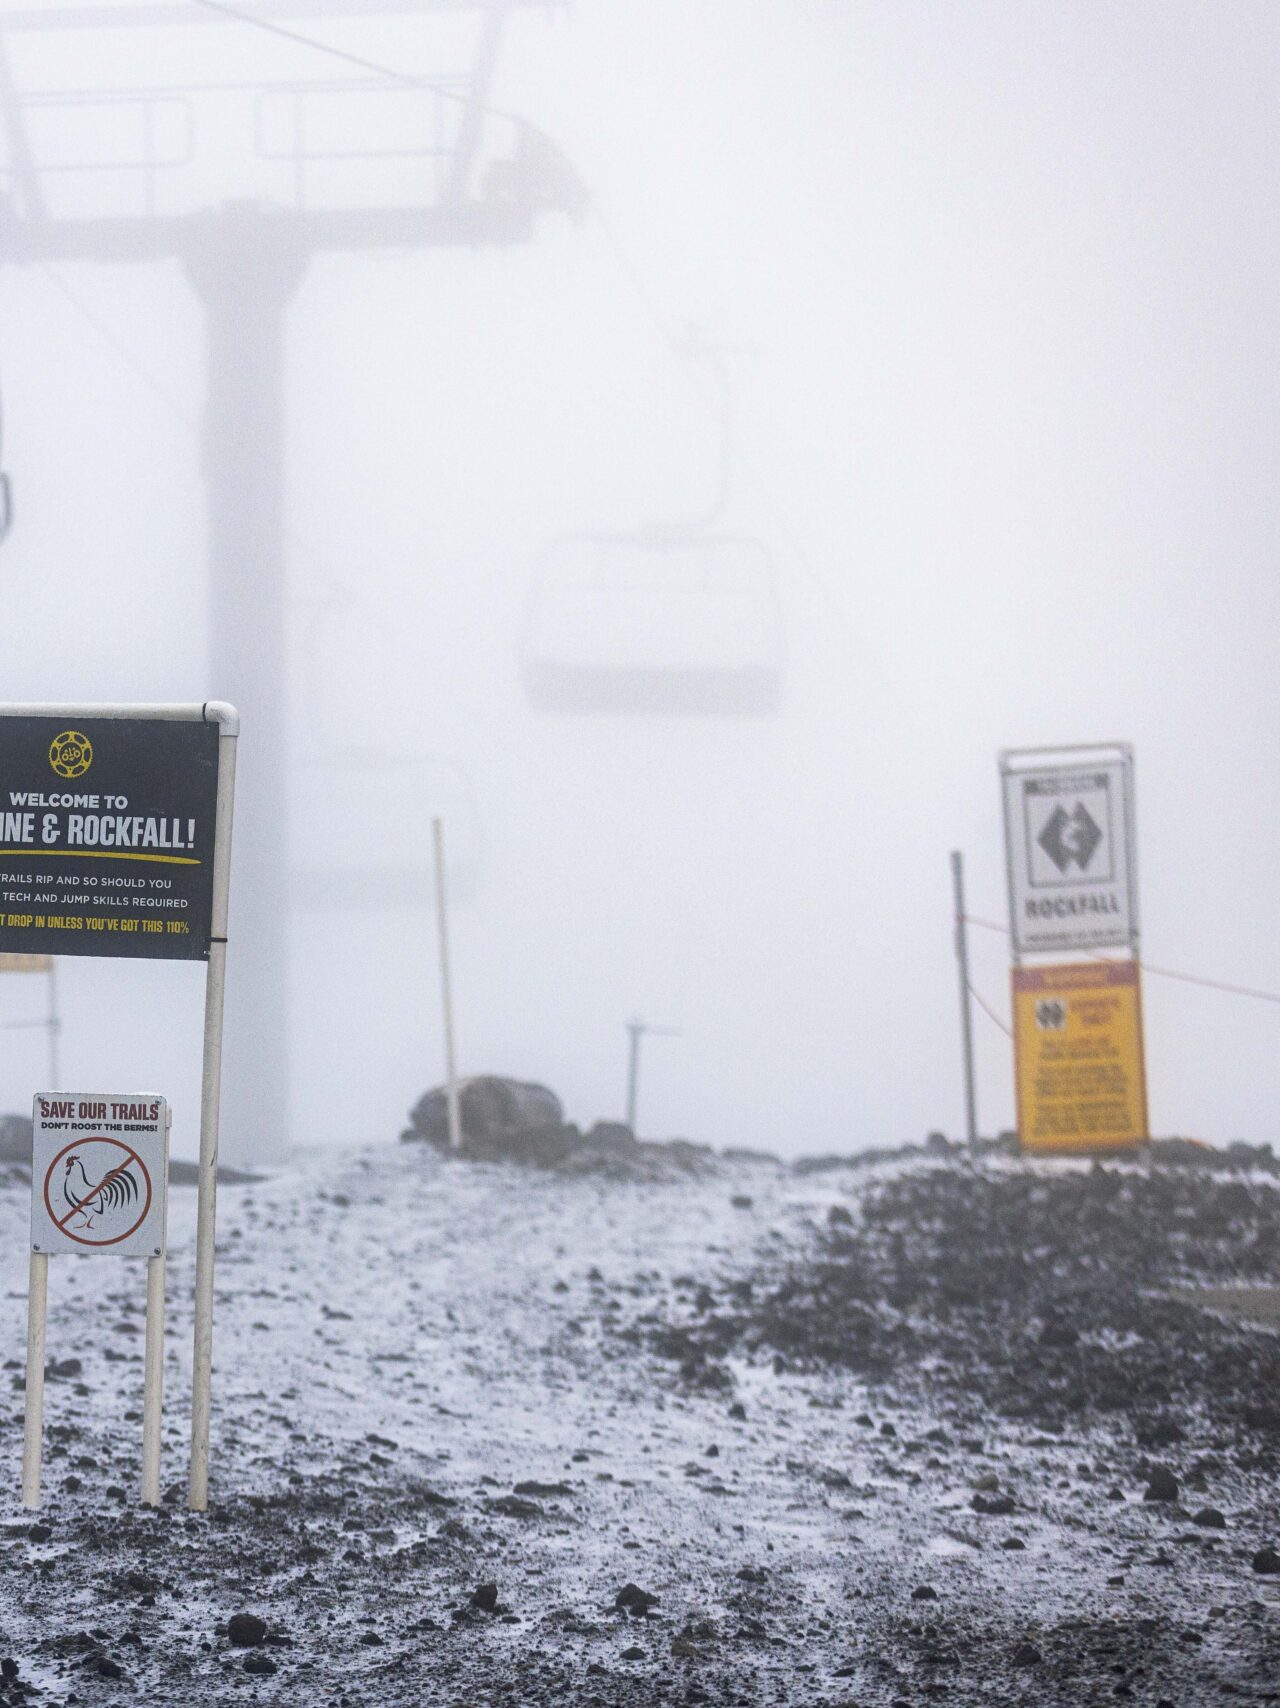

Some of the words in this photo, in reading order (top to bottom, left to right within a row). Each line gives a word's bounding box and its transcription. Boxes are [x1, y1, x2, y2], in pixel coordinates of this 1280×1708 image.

[9, 792, 99, 809] WELCOME
[104, 795, 128, 809] TO
[41, 813, 61, 844] &
[67, 814, 195, 848] ROCKFALL!
[36, 875, 53, 884] RIP
[56, 876, 80, 885] AND
[83, 877, 98, 886] SO
[101, 877, 145, 888] SHOULD
[149, 879, 172, 889] YOU
[3, 892, 31, 902] TECH
[34, 893, 57, 903] AND
[60, 895, 90, 904] JUMP
[93, 896, 129, 906] SKILLS
[132, 897, 188, 908] REQUIRED
[7, 914, 33, 927] DROP
[35, 916, 45, 928] IN
[47, 916, 83, 930] UNLESS
[85, 917, 119, 931] YOU'VE
[120, 919, 139, 932] GOT
[142, 920, 163, 933] THIS
[166, 921, 190, 934] 110%
[40, 1101, 75, 1118] SAVE
[78, 1102, 107, 1119] OUR
[110, 1103, 159, 1120] TRAILS
[41, 1121, 70, 1130] DON'T
[71, 1122, 102, 1130] ROOST
[104, 1123, 122, 1131] THE
[124, 1124, 158, 1132] BERMS!
